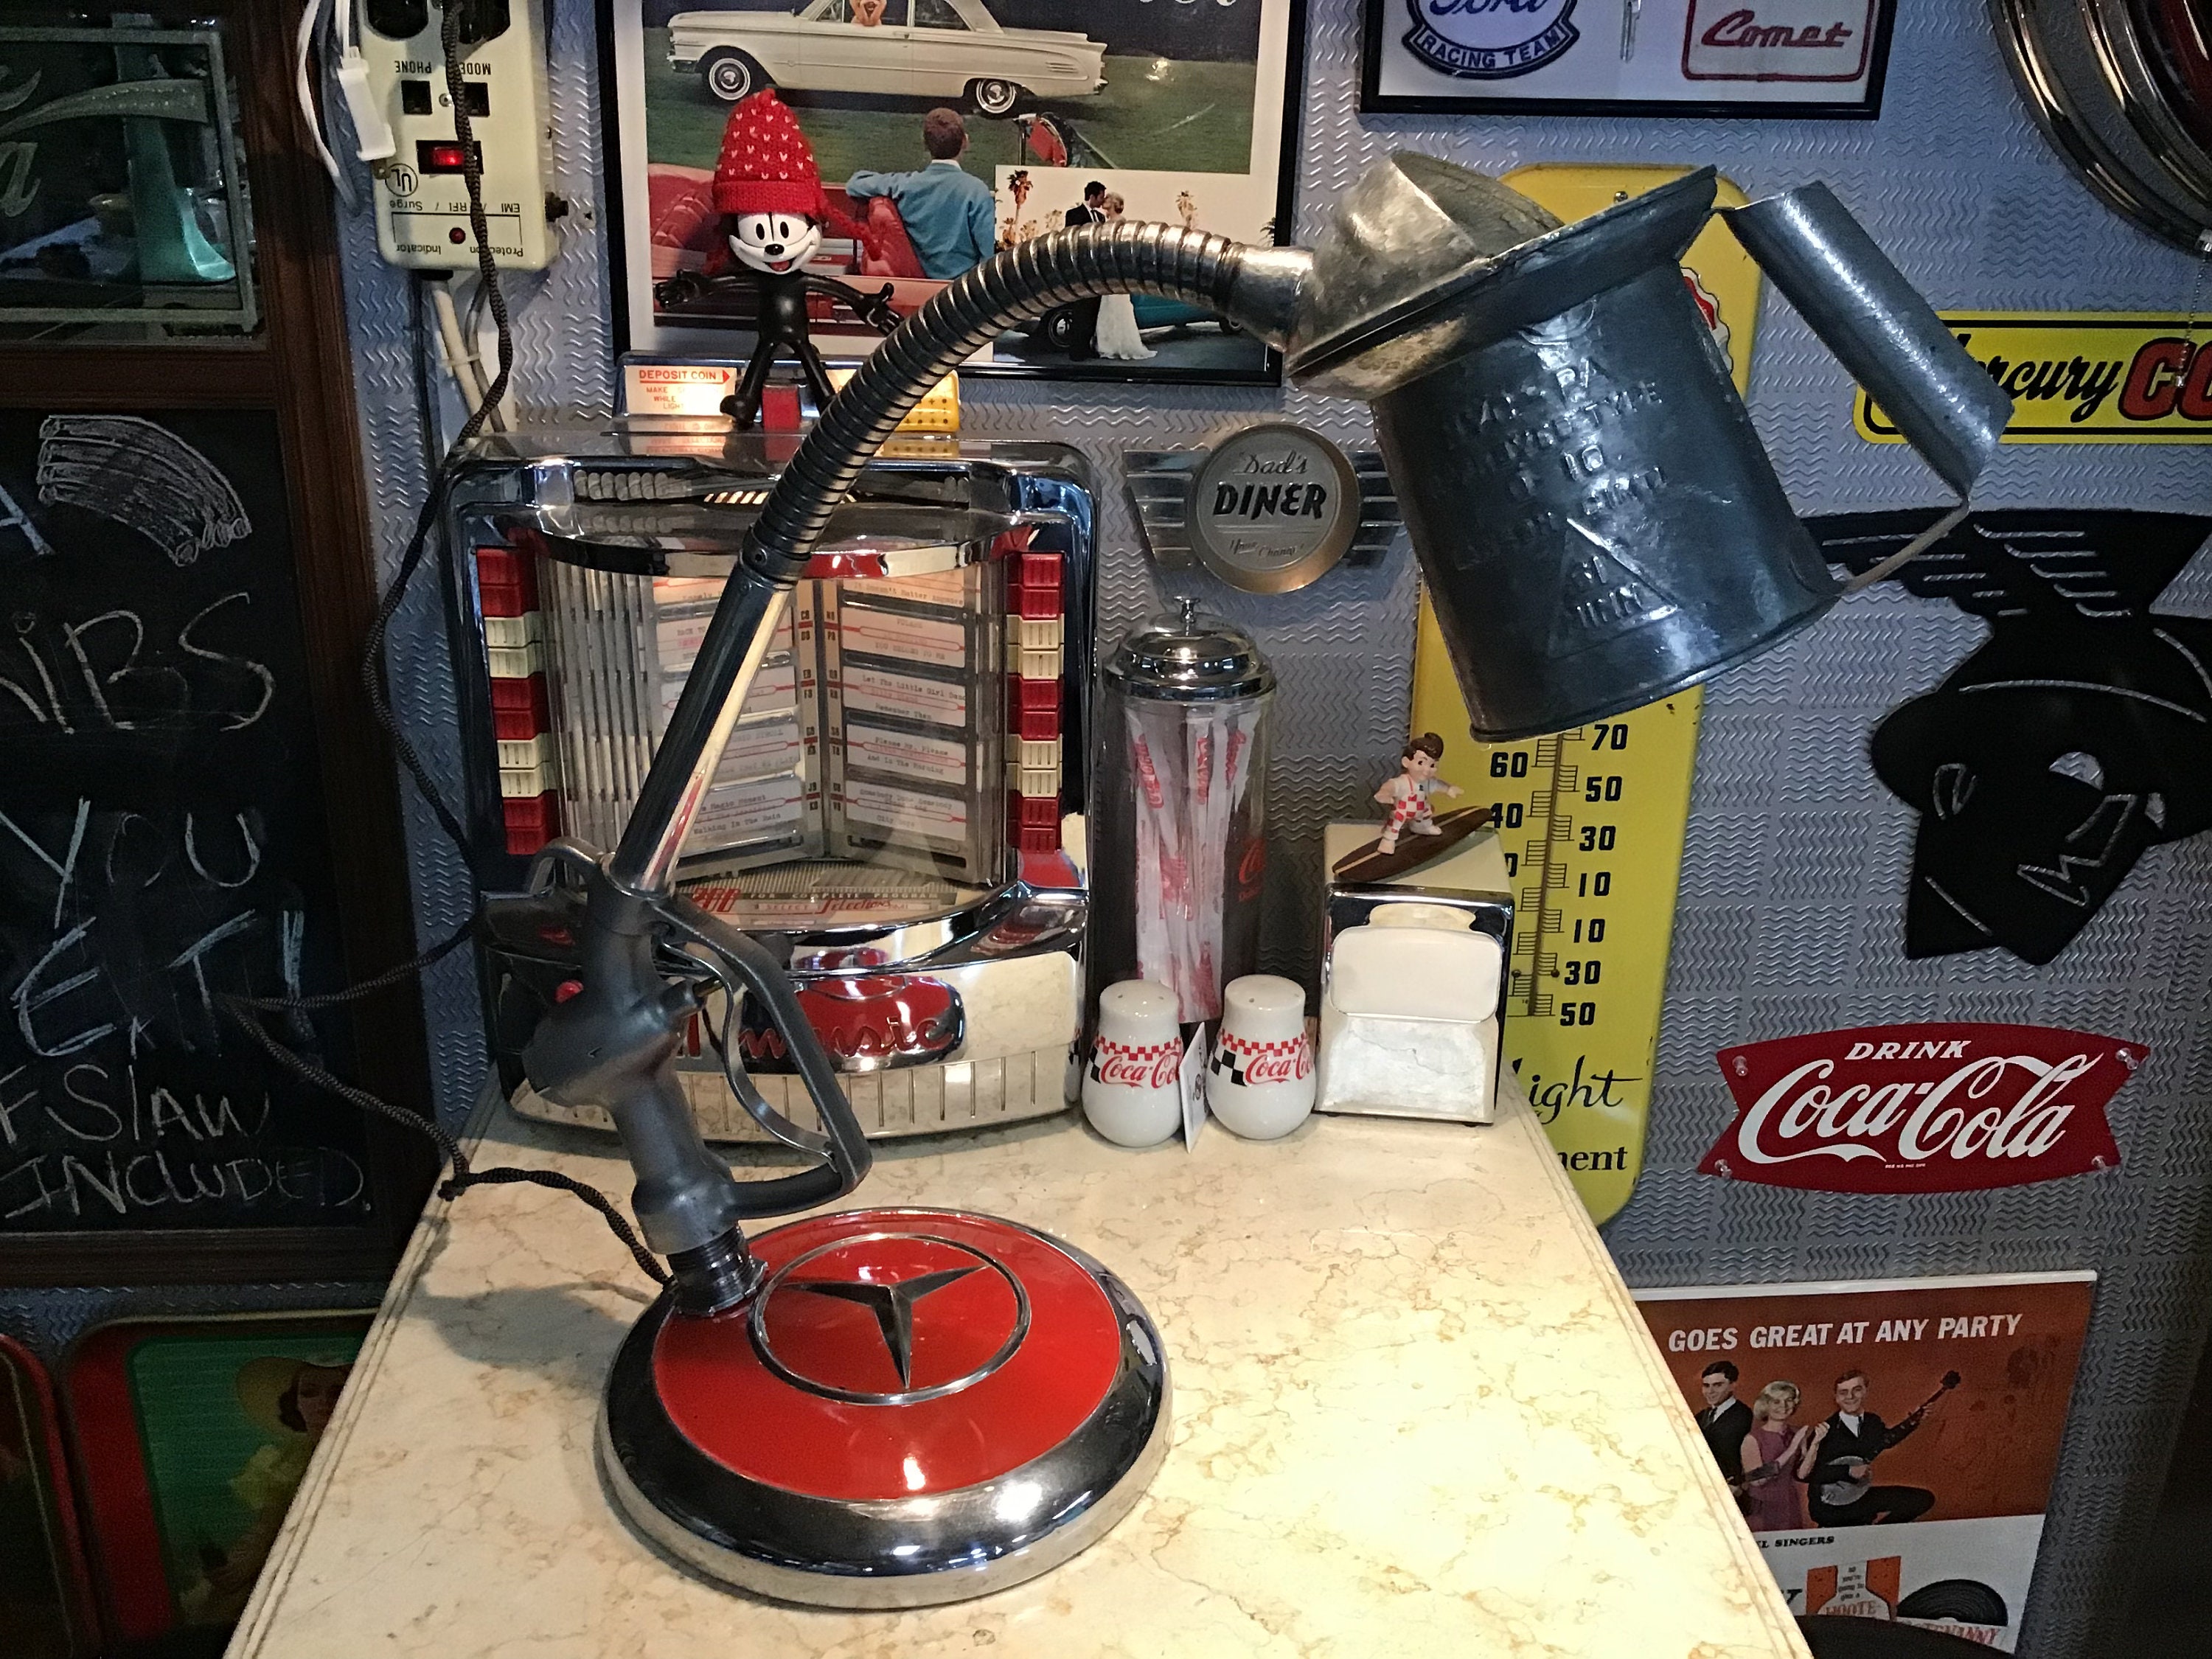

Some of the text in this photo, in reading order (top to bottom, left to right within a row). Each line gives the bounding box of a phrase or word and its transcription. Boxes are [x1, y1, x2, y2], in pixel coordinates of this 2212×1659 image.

[1700, 10, 1854, 49] Comet
[1419, 28, 1562, 68] RACING TEAM
[394, 60, 433, 74] PHONE
[459, 63, 492, 75] MODE
[389, 200, 423, 212] Surge
[448, 202, 467, 212] RFI
[501, 203, 521, 213] EMI
[395, 243, 441, 255] Indicator
[639, 369, 717, 380] DEPOSIT COIN
[646, 386, 669, 394] MAKE
[653, 394, 677, 403] WHILE
[1232, 449, 1308, 476] Dad's
[1212, 481, 1327, 521] DINER
[863, 674, 876, 684] Let
[880, 678, 893, 687] The
[896, 681, 926, 693] Little
[927, 687, 945, 698] Girl
[1590, 723, 1629, 751] 70
[1489, 751, 1528, 778] 60
[1585, 776, 1622, 802] 50
[1579, 825, 1615, 851] 30
[873, 892, 939, 900] PROGRAM
[1578, 872, 1611, 897] 10
[1573, 919, 1605, 944] 10
[1564, 960, 1601, 986] 30
[1559, 1002, 1596, 1026] 50
[1844, 1040, 1972, 1060] DRINK
[1737, 1051, 2105, 1164] Coca-Cola
[1668, 1312, 2023, 1352] GOES GREAT AT ANY PARTY
[1774, 1535, 1835, 1548] SINGERS
